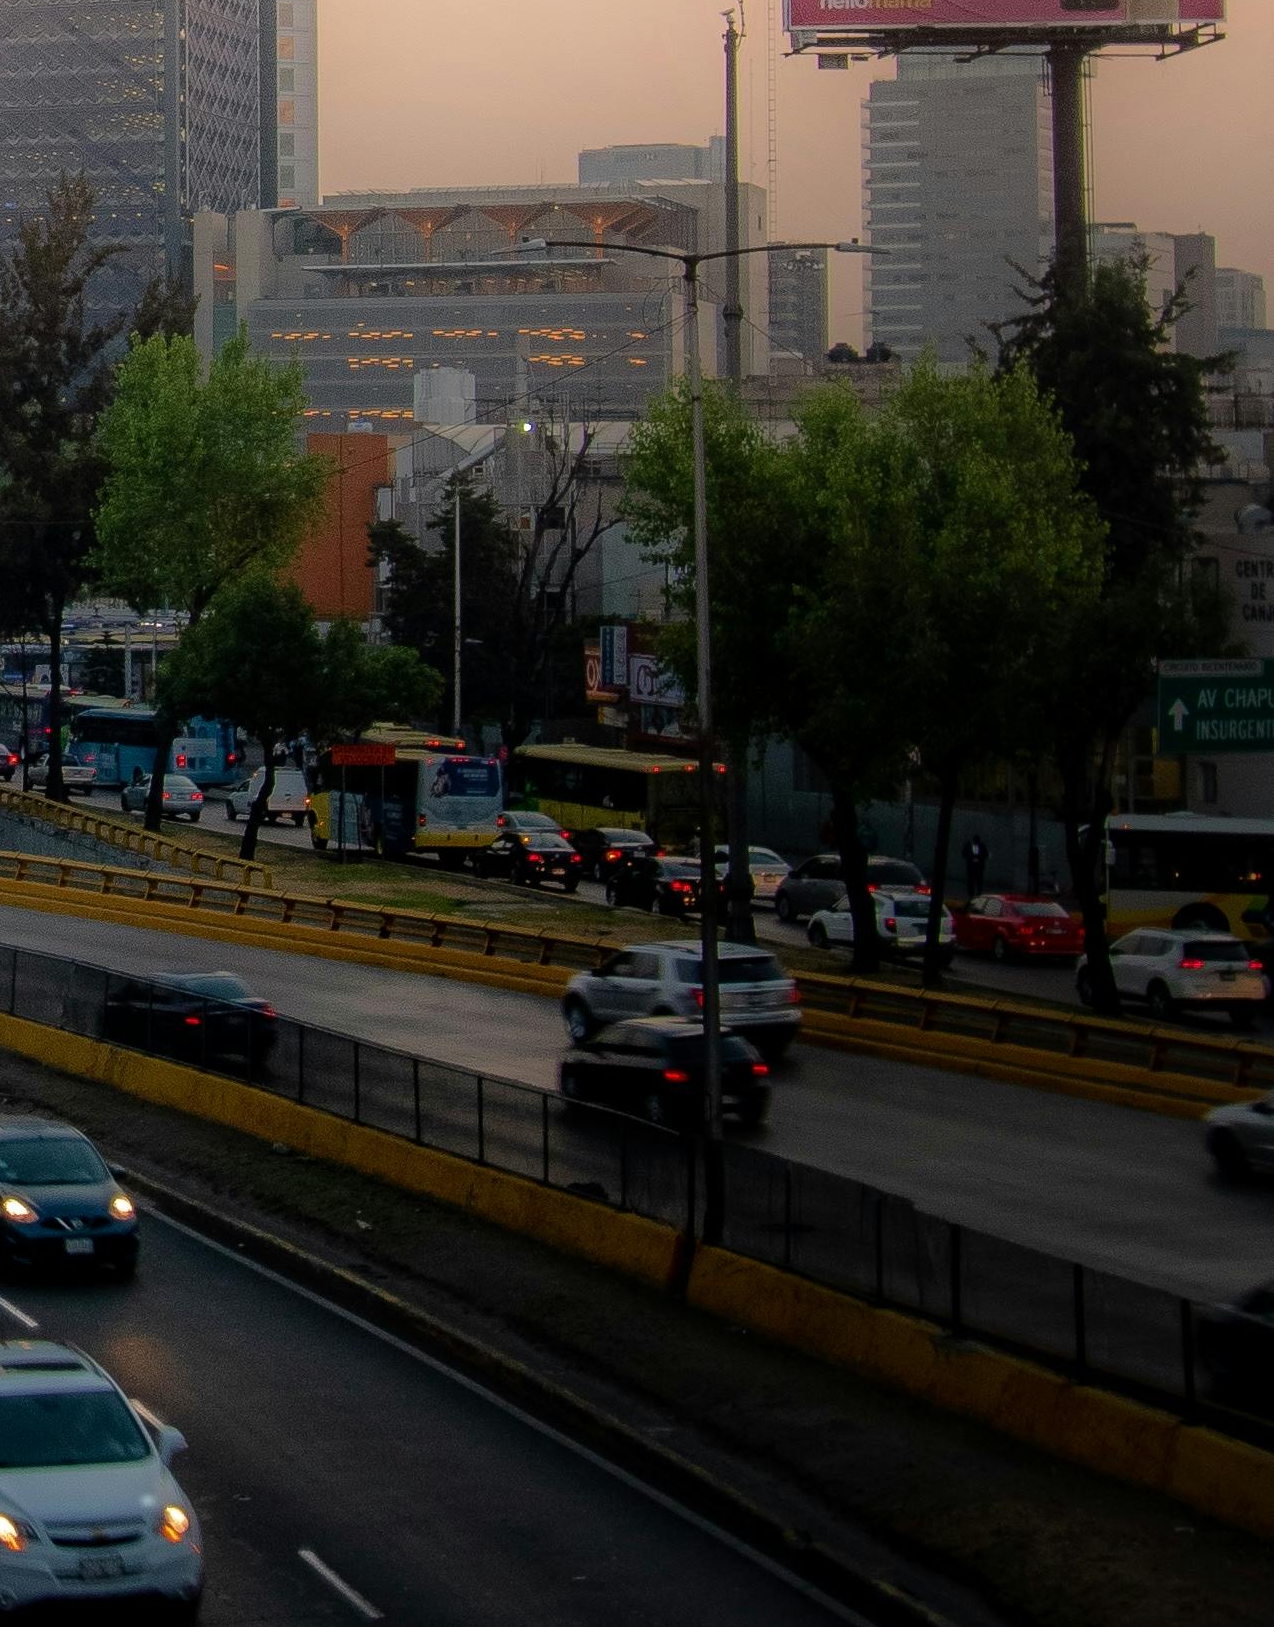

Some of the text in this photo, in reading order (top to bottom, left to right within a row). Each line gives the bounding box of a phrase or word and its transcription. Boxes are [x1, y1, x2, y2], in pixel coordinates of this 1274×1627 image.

[1251, 583, 1265, 599] DE
[1197, 688, 1217, 709] AV
[1196, 718, 1274, 741] INSURGENT
